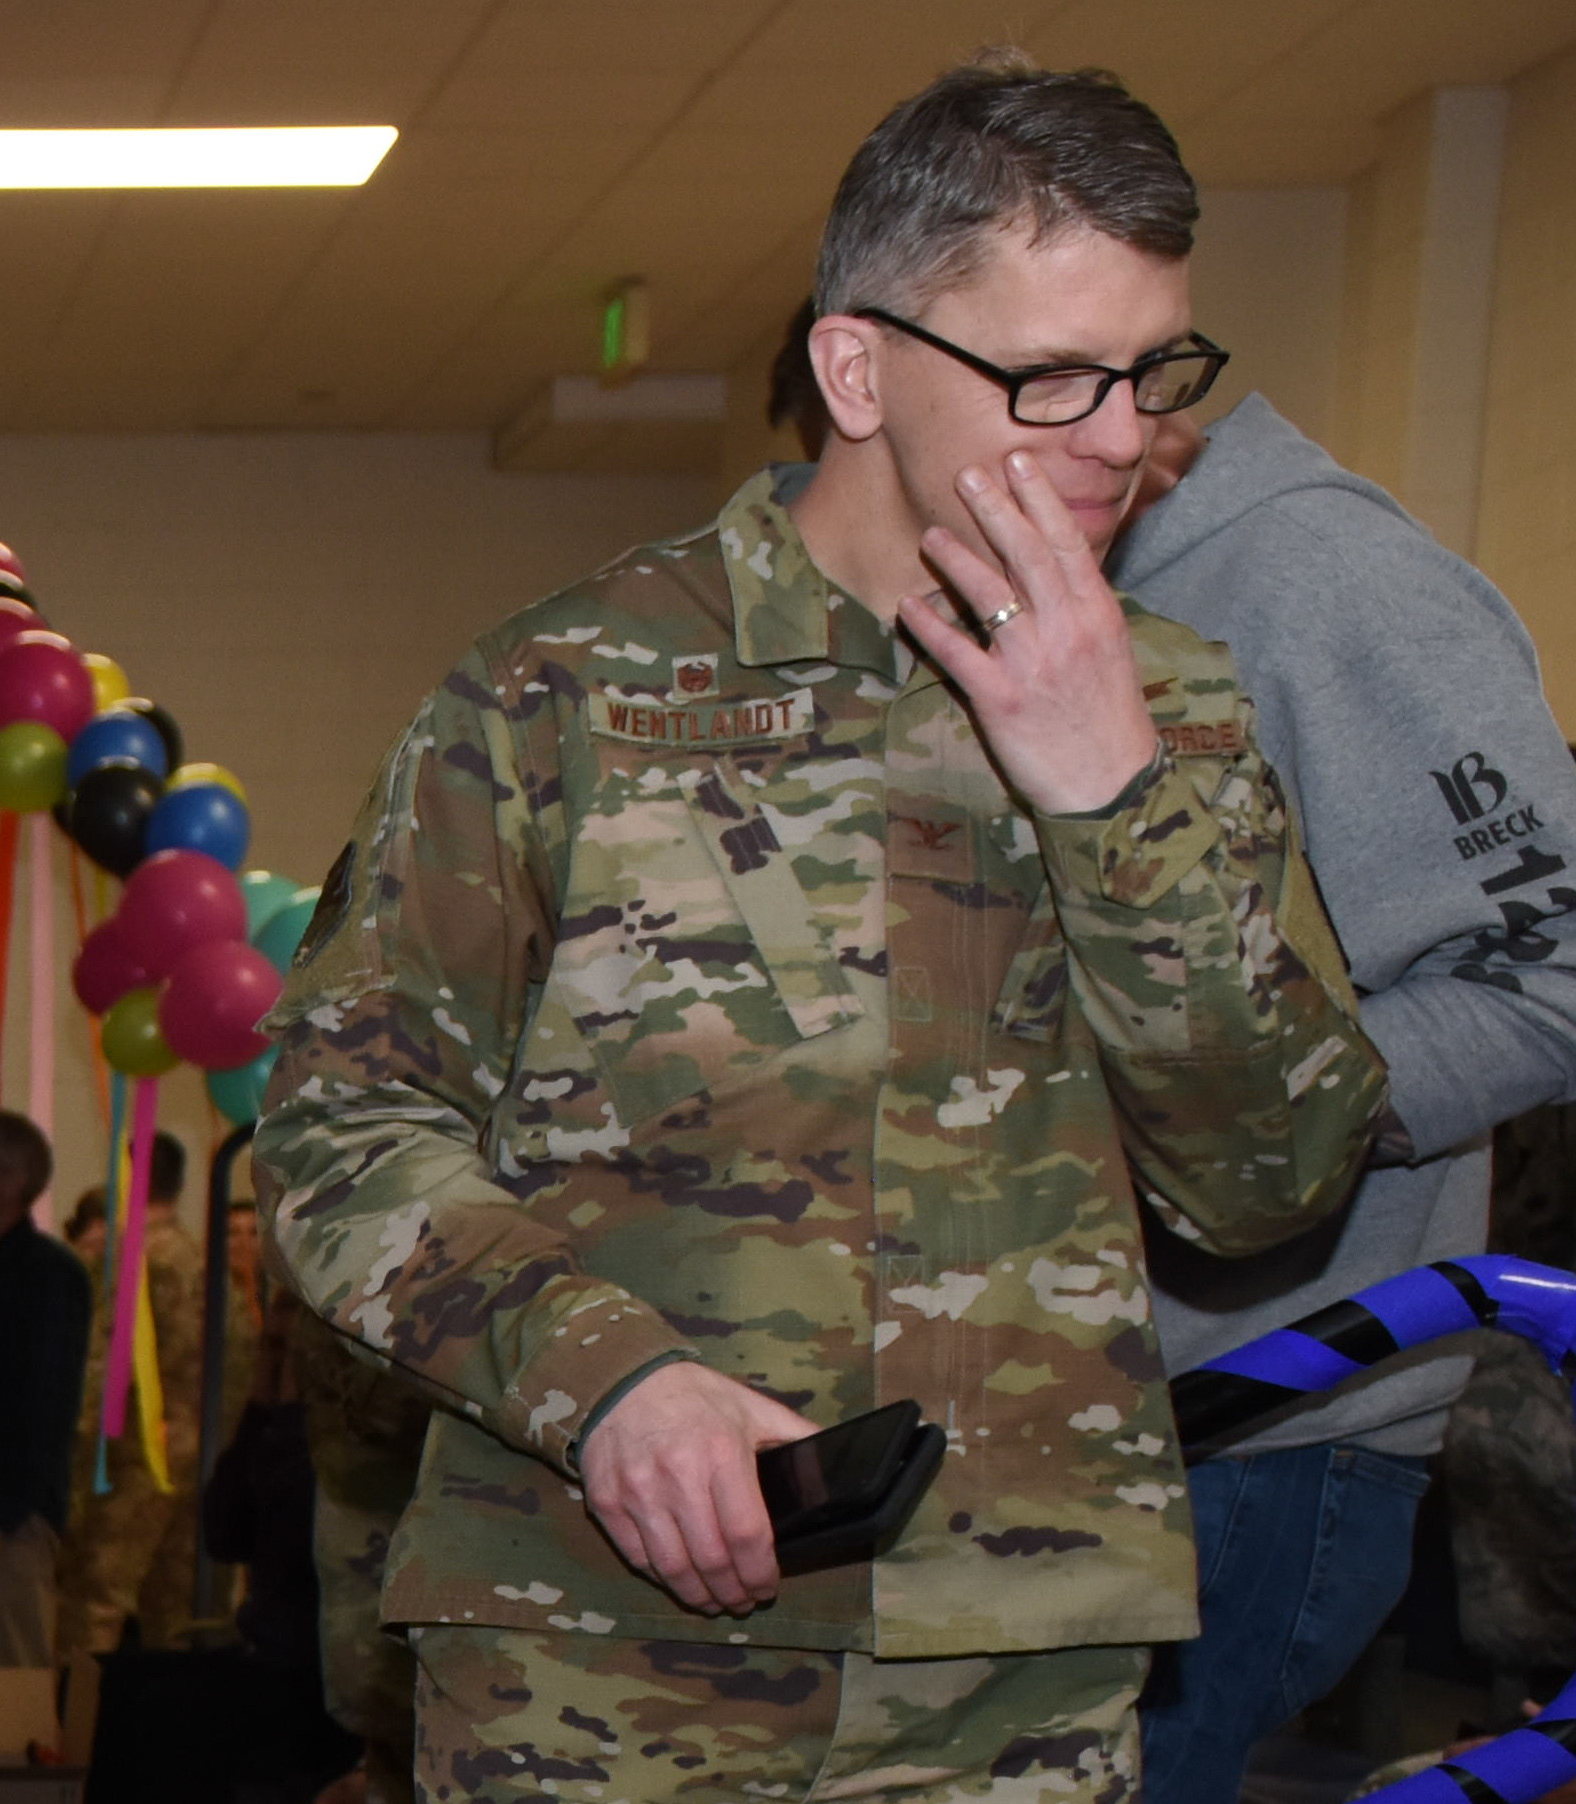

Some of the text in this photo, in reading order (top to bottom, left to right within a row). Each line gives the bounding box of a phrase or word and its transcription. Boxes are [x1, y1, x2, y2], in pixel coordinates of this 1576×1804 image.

[607, 698, 795, 742] WENTLANDT
[1159, 723, 1237, 752] ORCE
[1453, 804, 1545, 861] BRECK
